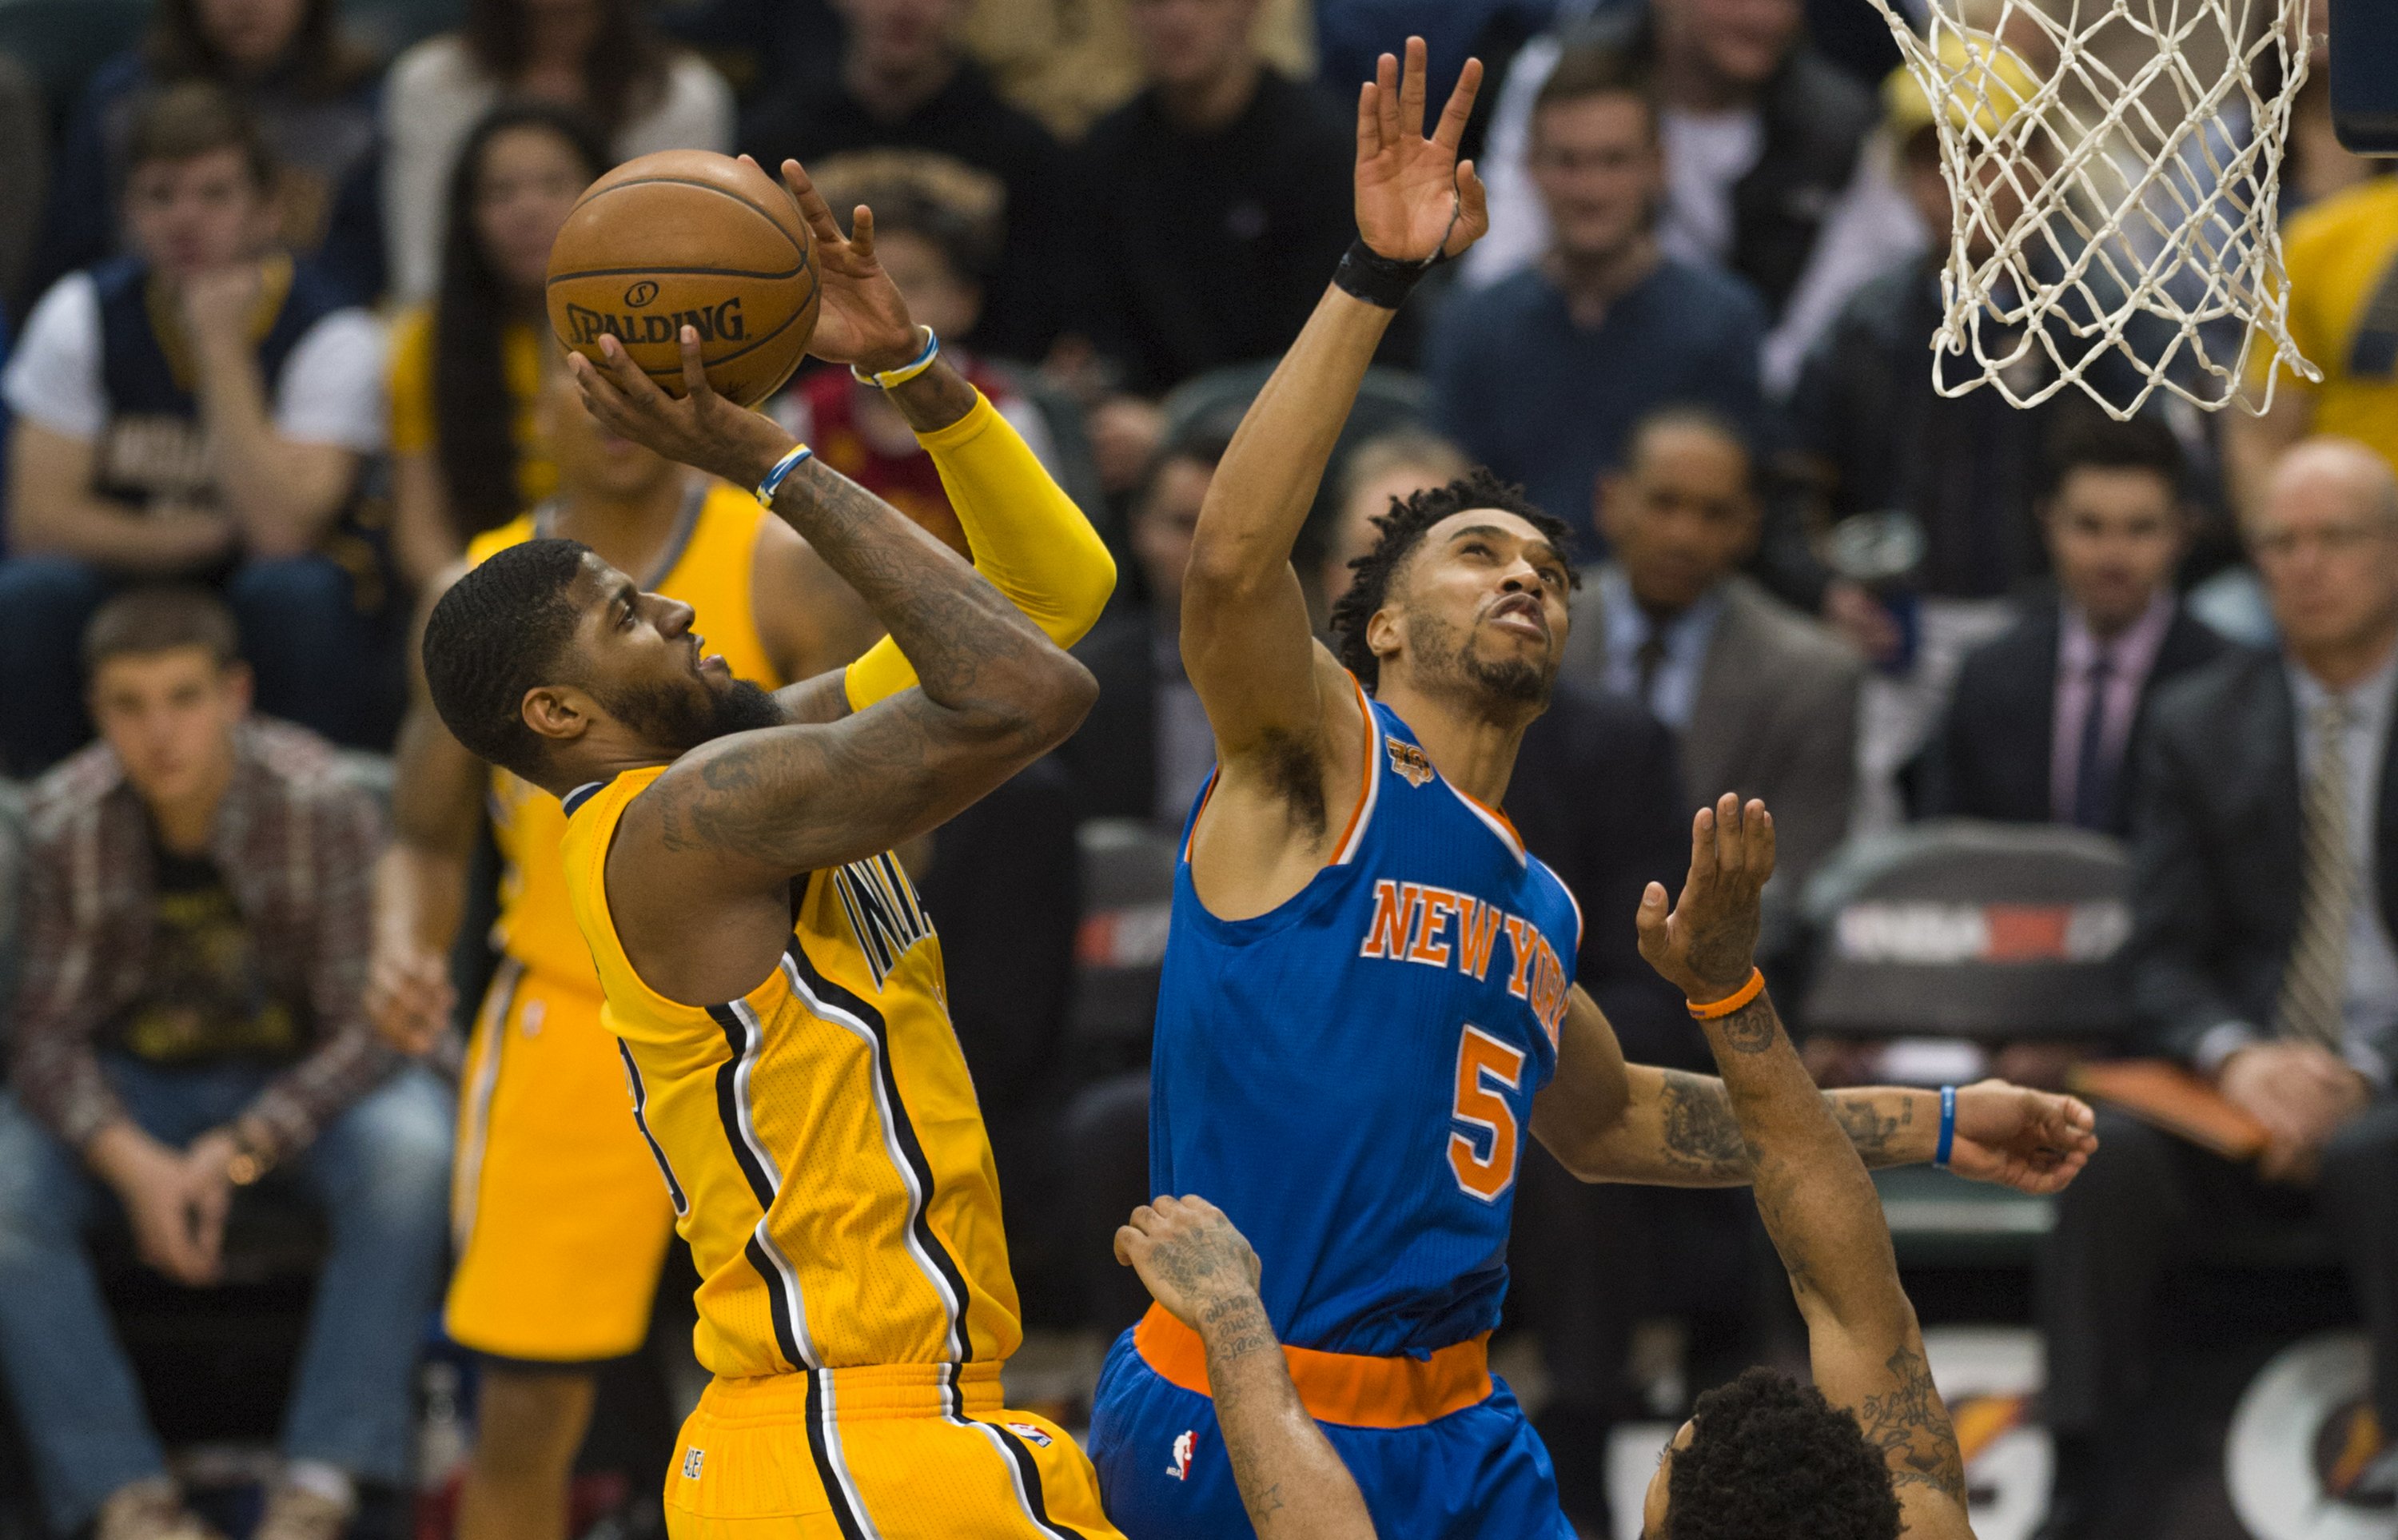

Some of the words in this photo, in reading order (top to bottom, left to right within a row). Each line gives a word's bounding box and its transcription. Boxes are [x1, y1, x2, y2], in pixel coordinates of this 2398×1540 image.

[565, 296, 744, 345] SPALDING
[1360, 878, 1502, 983] NEW
[1446, 1023, 1526, 1203] 5
